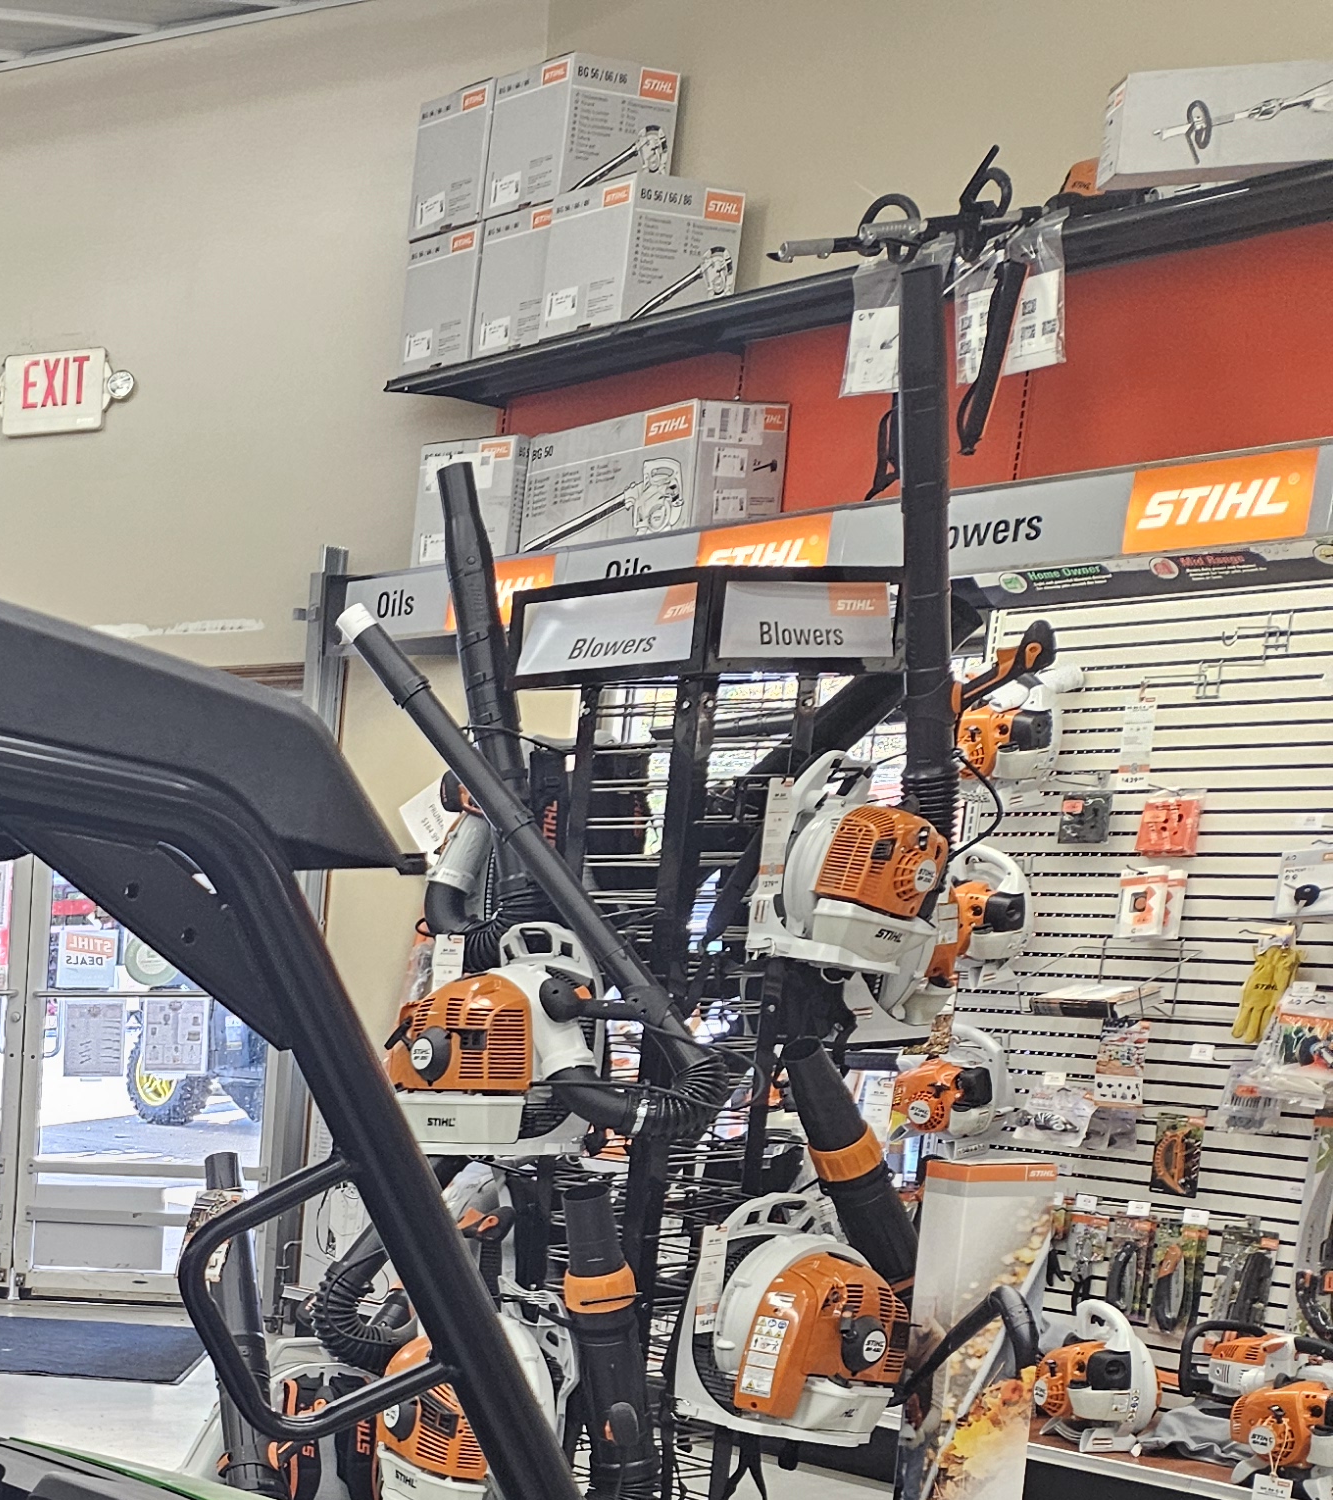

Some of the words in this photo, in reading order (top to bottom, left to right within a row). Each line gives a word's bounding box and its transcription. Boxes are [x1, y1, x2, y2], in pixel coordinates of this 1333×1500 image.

[544, 68, 567, 82] STIHL
[577, 65, 589, 77] BG
[591, 67, 599, 79] 56
[642, 78, 674, 94] STIHL
[463, 92, 484, 106] STIHL
[604, 188, 628, 203] STIHL
[640, 187, 652, 200] BG
[707, 201, 739, 216] STIHL
[452, 237, 473, 250] STIHL
[21, 355, 91, 410] EXIT
[763, 412, 783, 424] TIHL
[649, 415, 690, 437] STIHL
[532, 447, 544, 461] BG
[544, 445, 554, 458] 50
[1136, 475, 1290, 531] STIHL
[949, 515, 1043, 550] owers
[1027, 569, 1060, 582] Home
[1061, 564, 1101, 578] Owner
[376, 589, 415, 618] Oils
[836, 598, 875, 612] STIHL
[759, 621, 844, 647] Blowers
[568, 635, 657, 660] Blowers
[874, 928, 904, 943] STIHL
[426, 1117, 453, 1127] STIHL
[1029, 1170, 1055, 1178] STIHL
[395, 1468, 418, 1487] STIHL
